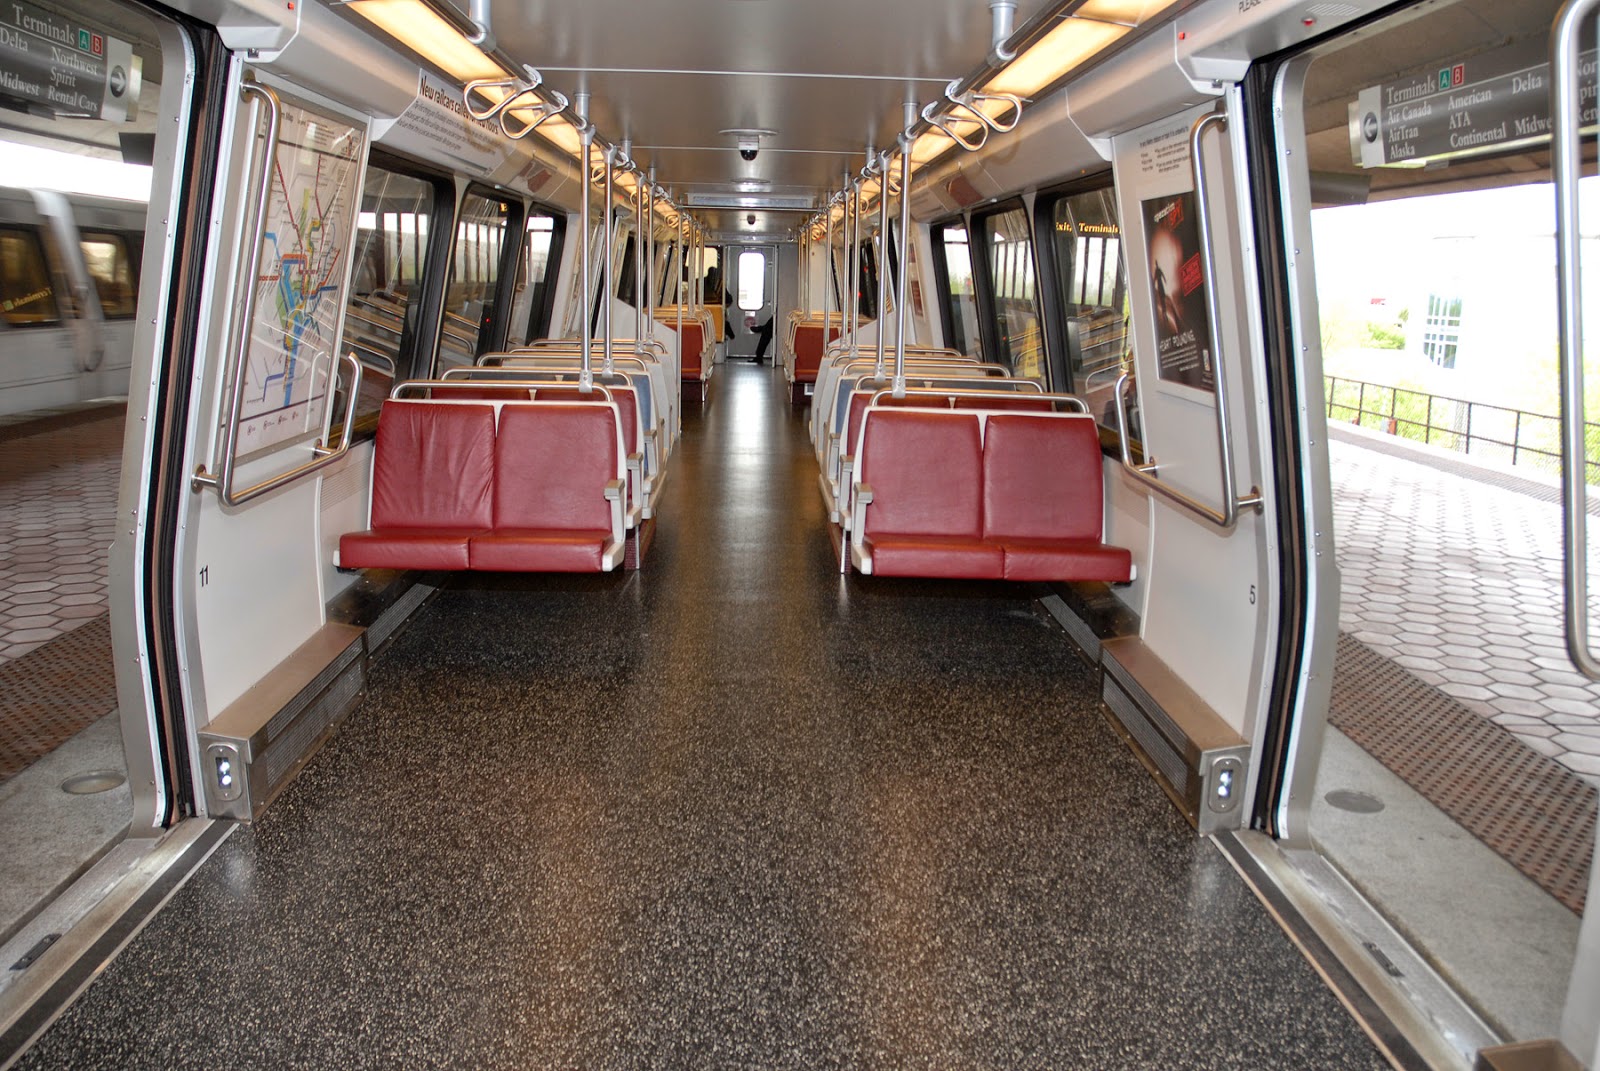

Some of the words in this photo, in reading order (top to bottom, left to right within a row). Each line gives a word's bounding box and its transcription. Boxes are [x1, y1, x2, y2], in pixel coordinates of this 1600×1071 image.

[0, 26, 28, 52] Delta
[12, 4, 75, 46] Terminals
[81, 34, 89, 50] A
[93, 37, 102, 54] B
[51, 46, 98, 75] Northwest
[50, 66, 76, 88] Spirit
[1386, 75, 1435, 105] Terminals
[1440, 73, 1449, 88] A
[1453, 67, 1462, 84] B
[1512, 73, 1542, 95] Delta
[48, 85, 77, 107] Rental
[79, 94, 98, 112] Cars
[420, 75, 434, 100] New
[434, 88, 454, 112] railcars
[1448, 89, 1492, 111] American
[1387, 109, 1400, 125] Air
[1402, 101, 1432, 121] Canada
[1449, 111, 1471, 130] ATA
[1388, 125, 1419, 143] AirTran
[1450, 122, 1507, 148] Continental
[1514, 114, 1553, 136] Midwe
[1390, 142, 1415, 159] Alaska
[1079, 223, 1118, 234] Terminals
[199, 565, 209, 587] 11
[1249, 584, 1256, 605] 5
